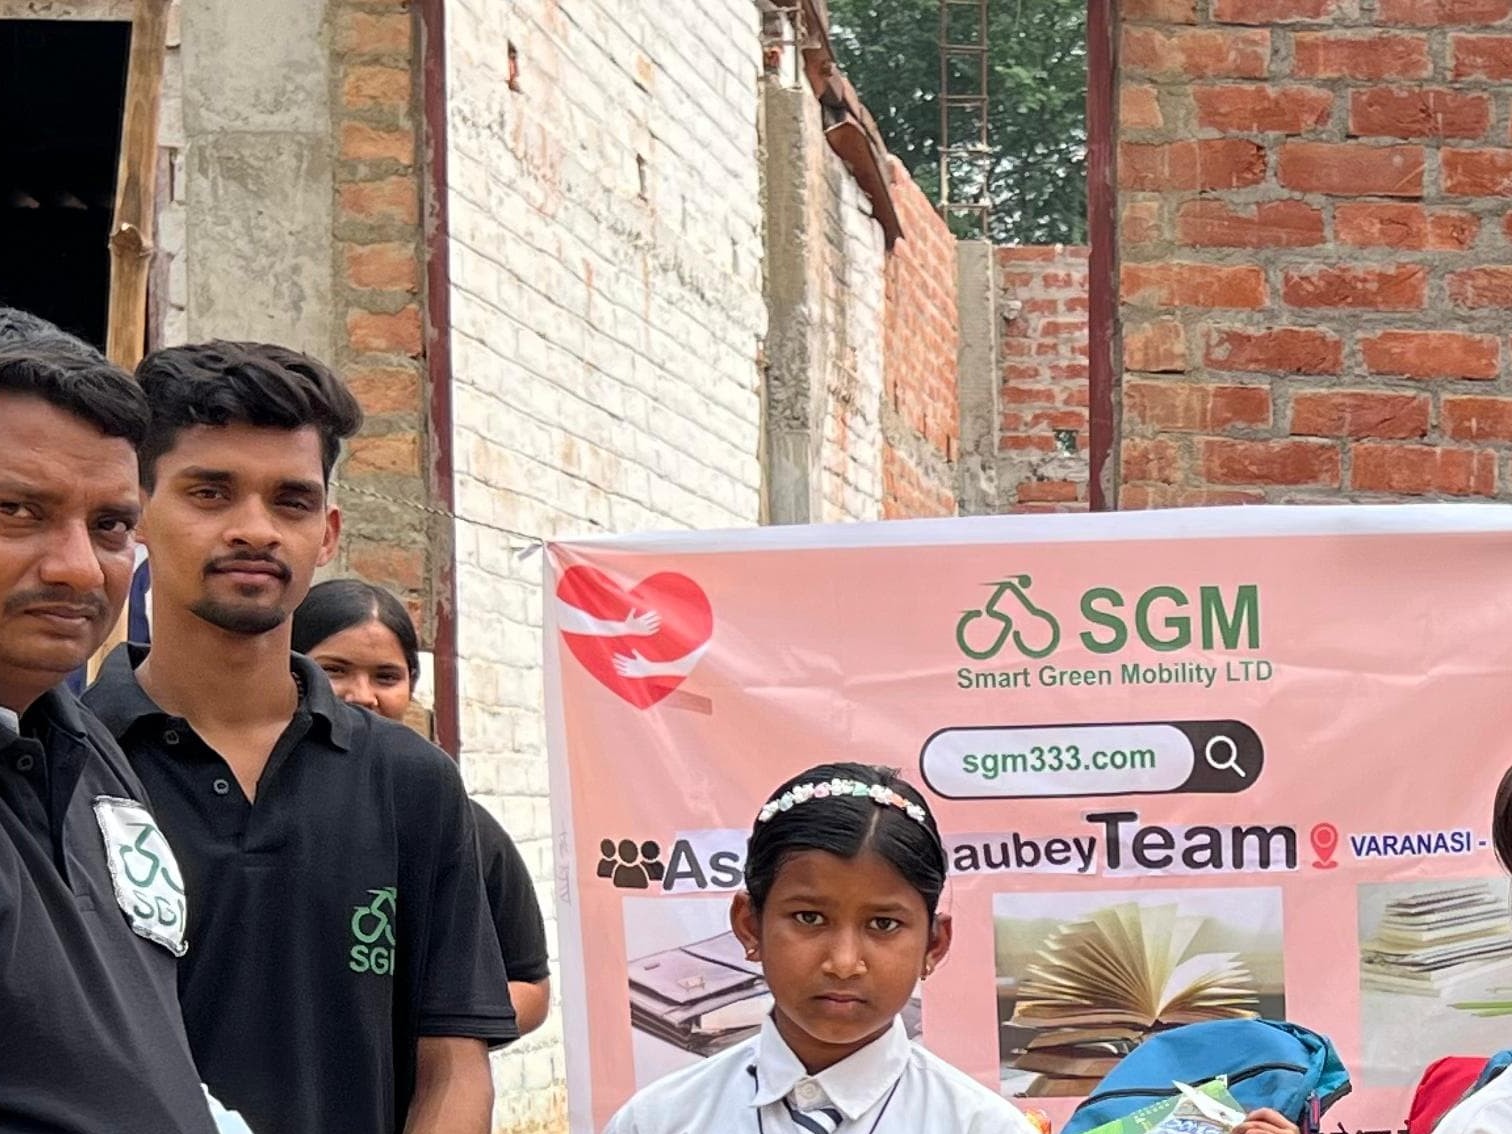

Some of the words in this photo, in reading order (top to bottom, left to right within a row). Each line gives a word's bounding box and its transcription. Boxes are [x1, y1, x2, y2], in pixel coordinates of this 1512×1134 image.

[1079, 585, 1260, 654] SGM
[957, 667, 1030, 688] Smart
[1038, 665, 1112, 687] Green
[1121, 661, 1217, 687] Mobility
[1226, 660, 1272, 682] LTD
[962, 744, 1156, 779] sgm333.com
[953, 832, 1097, 873] aubey
[1086, 811, 1298, 871] Team
[1351, 831, 1472, 857] VARANASI
[133, 889, 184, 933] SG
[350, 944, 394, 976] SG
